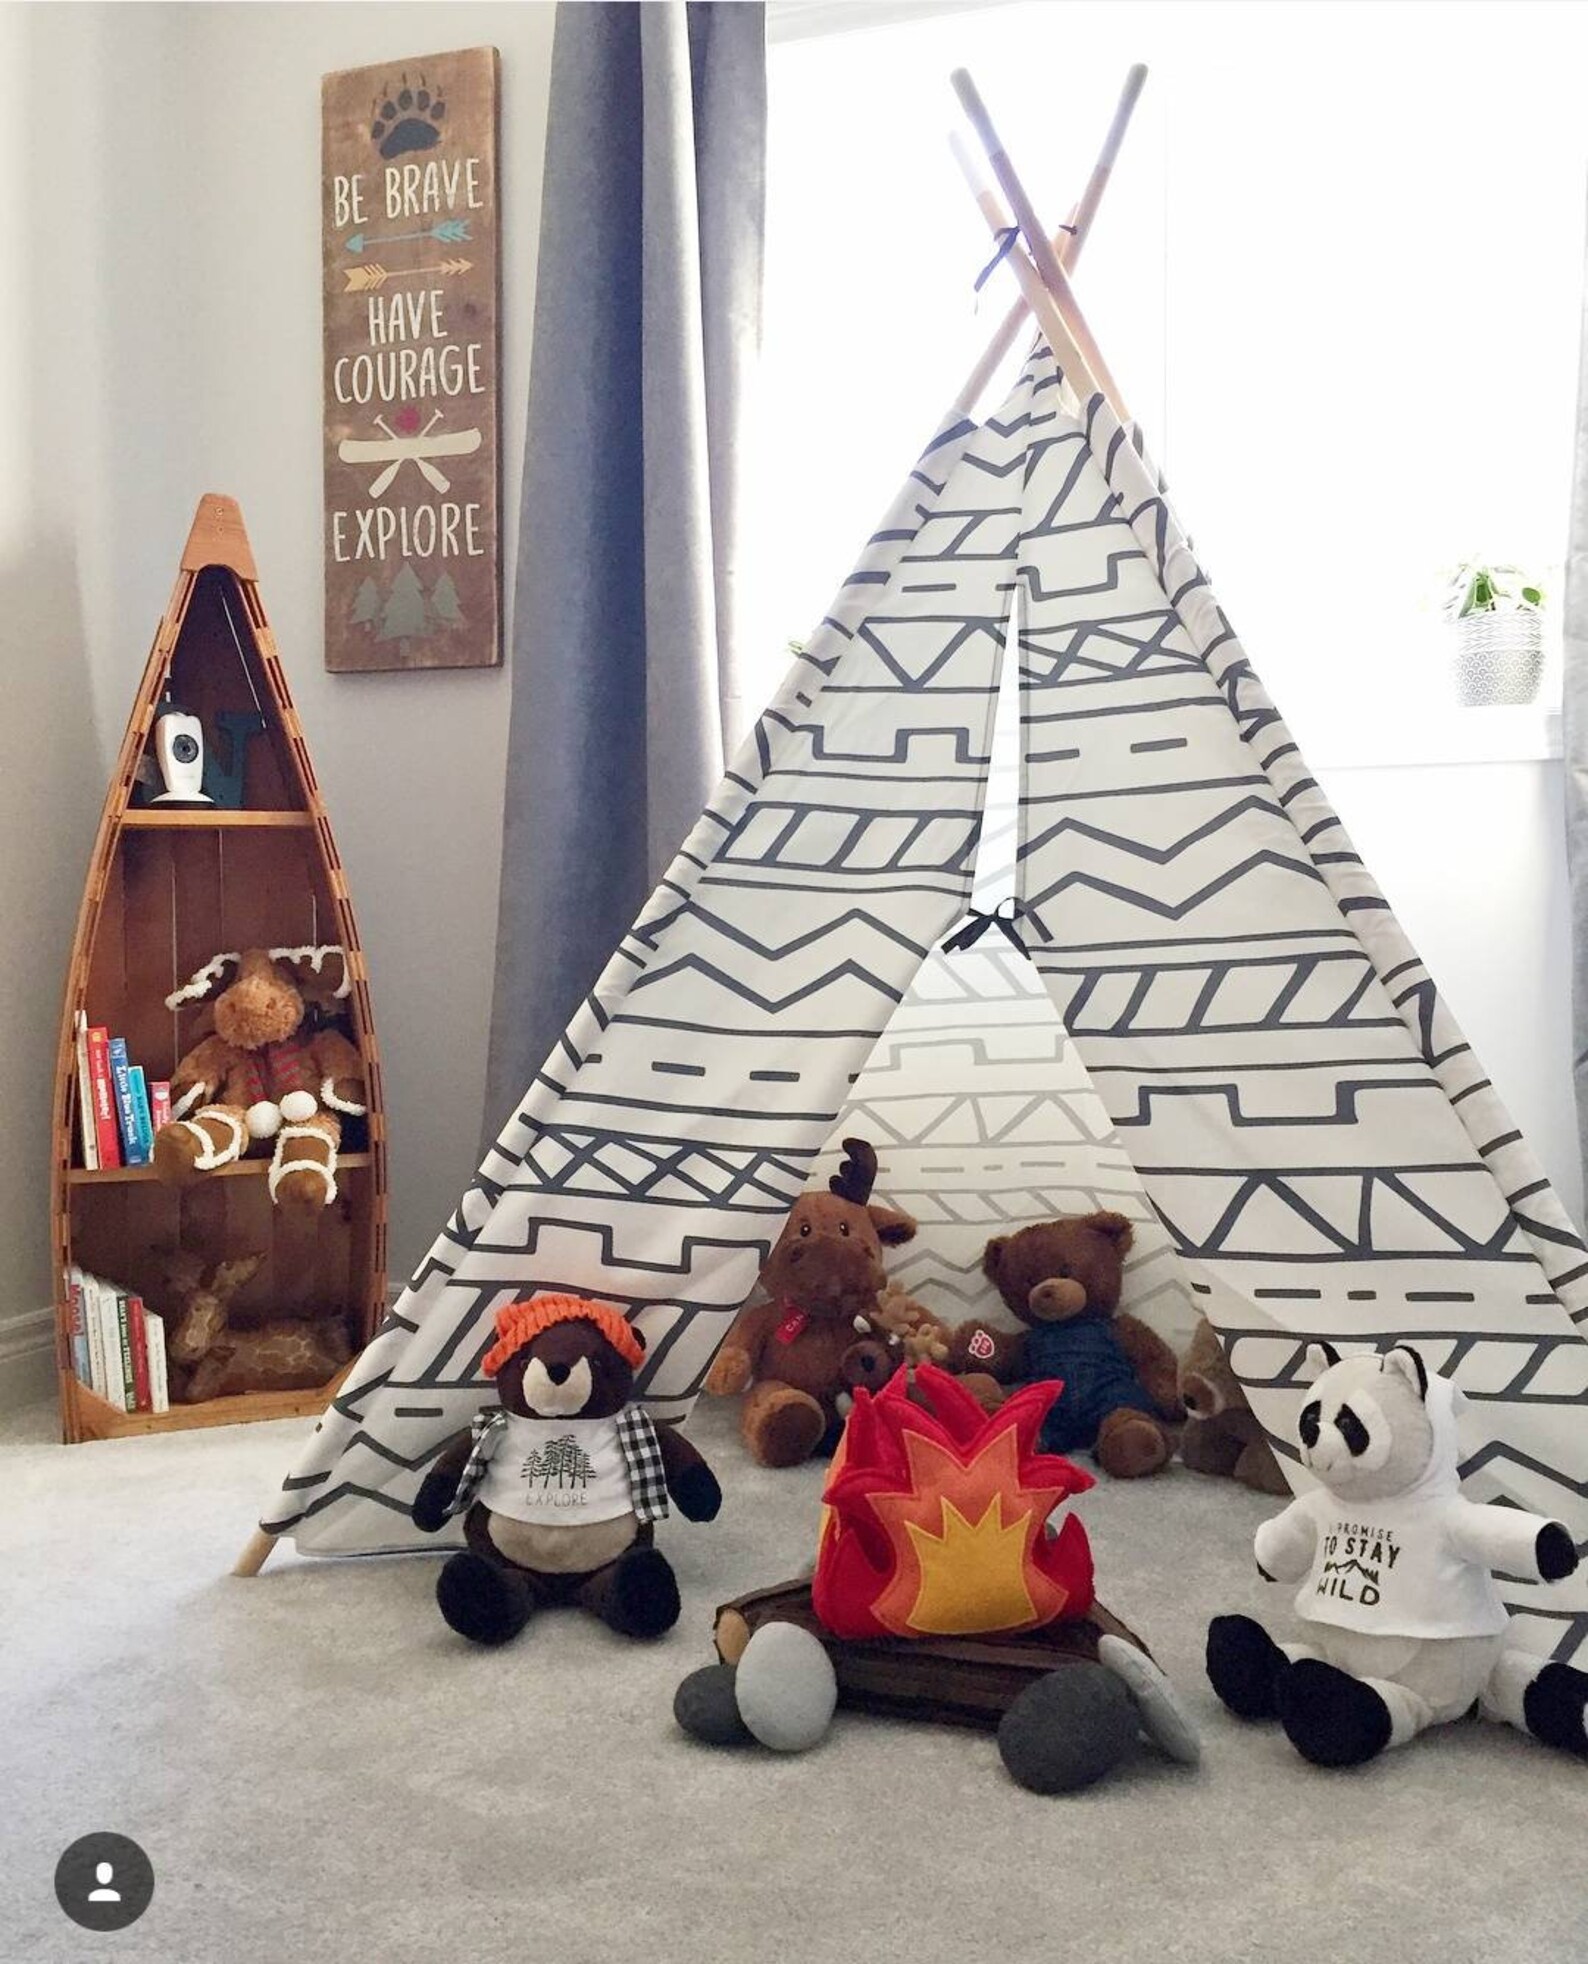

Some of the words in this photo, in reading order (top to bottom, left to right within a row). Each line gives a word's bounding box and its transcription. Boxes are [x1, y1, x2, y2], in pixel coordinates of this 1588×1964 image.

[334, 174, 368, 227] BE
[385, 158, 484, 219] BRAVE
[368, 290, 448, 346] HAVE
[334, 343, 486, 404] COURAGE
[333, 502, 484, 562] EXPLORE
[525, 1492, 589, 1508] EXPLORE
[1324, 1535, 1338, 1557] TO
[1344, 1537, 1400, 1569] STAY
[1316, 1577, 1381, 1606] WILD
